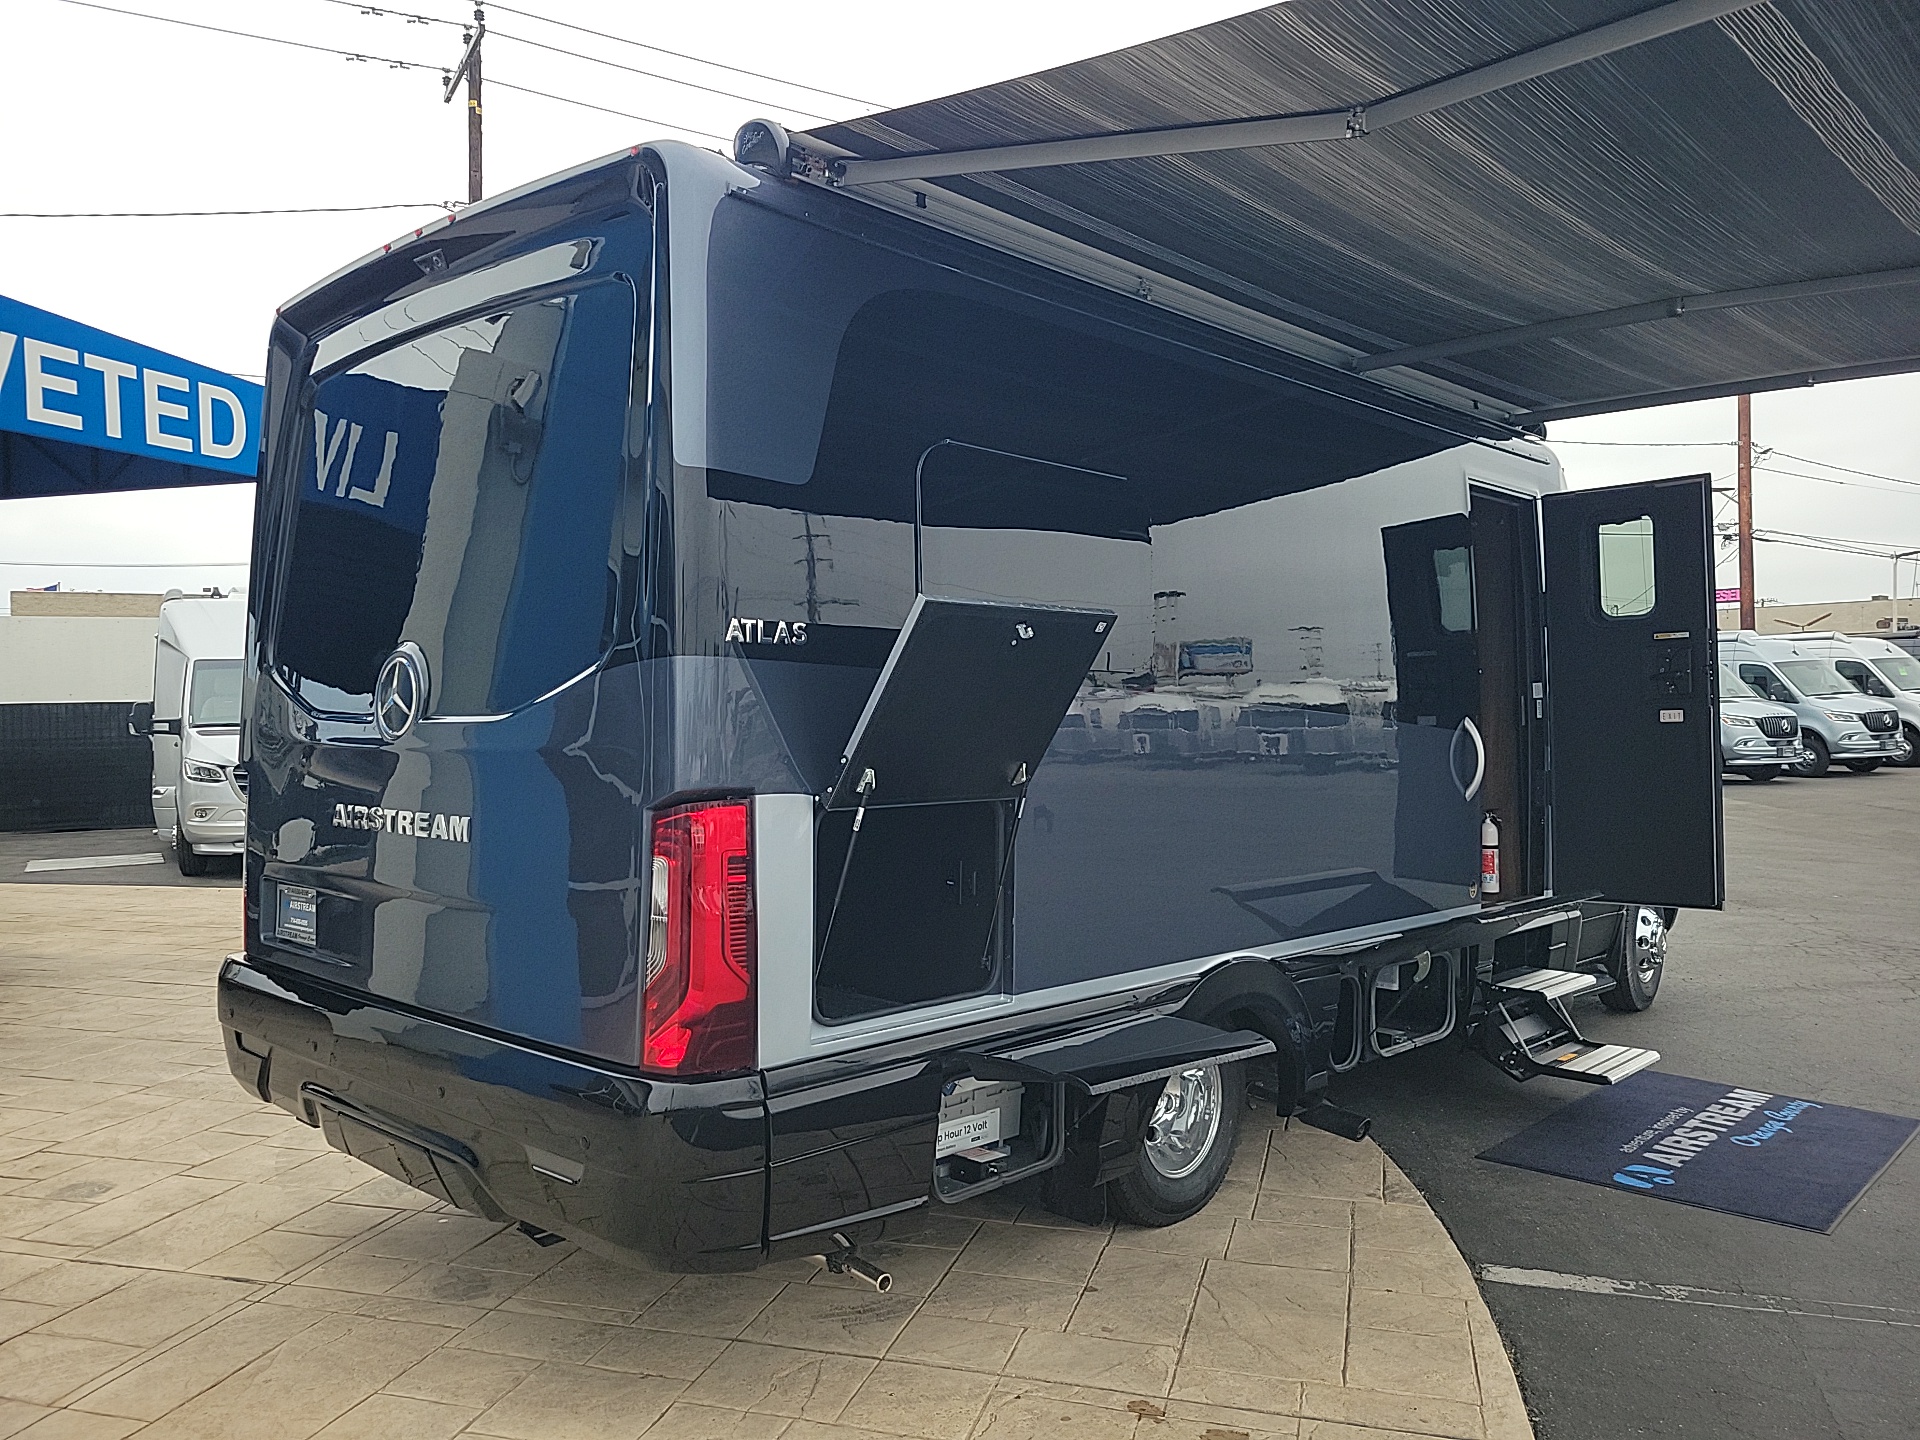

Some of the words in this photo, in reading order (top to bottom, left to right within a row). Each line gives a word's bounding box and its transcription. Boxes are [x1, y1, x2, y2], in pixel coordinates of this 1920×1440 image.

[725, 617, 807, 646] ATLAS
[1662, 712, 1681, 721] EXIT
[332, 803, 471, 843] AIRSTREAM
[944, 1128, 963, 1141] Hour
[963, 1124, 971, 1135] 12
[972, 1119, 988, 1132] Volt
[1642, 1088, 1774, 1168] AIRSTREAM
[1730, 1119, 1794, 1147] Orange
[1763, 1099, 1824, 1121] County
